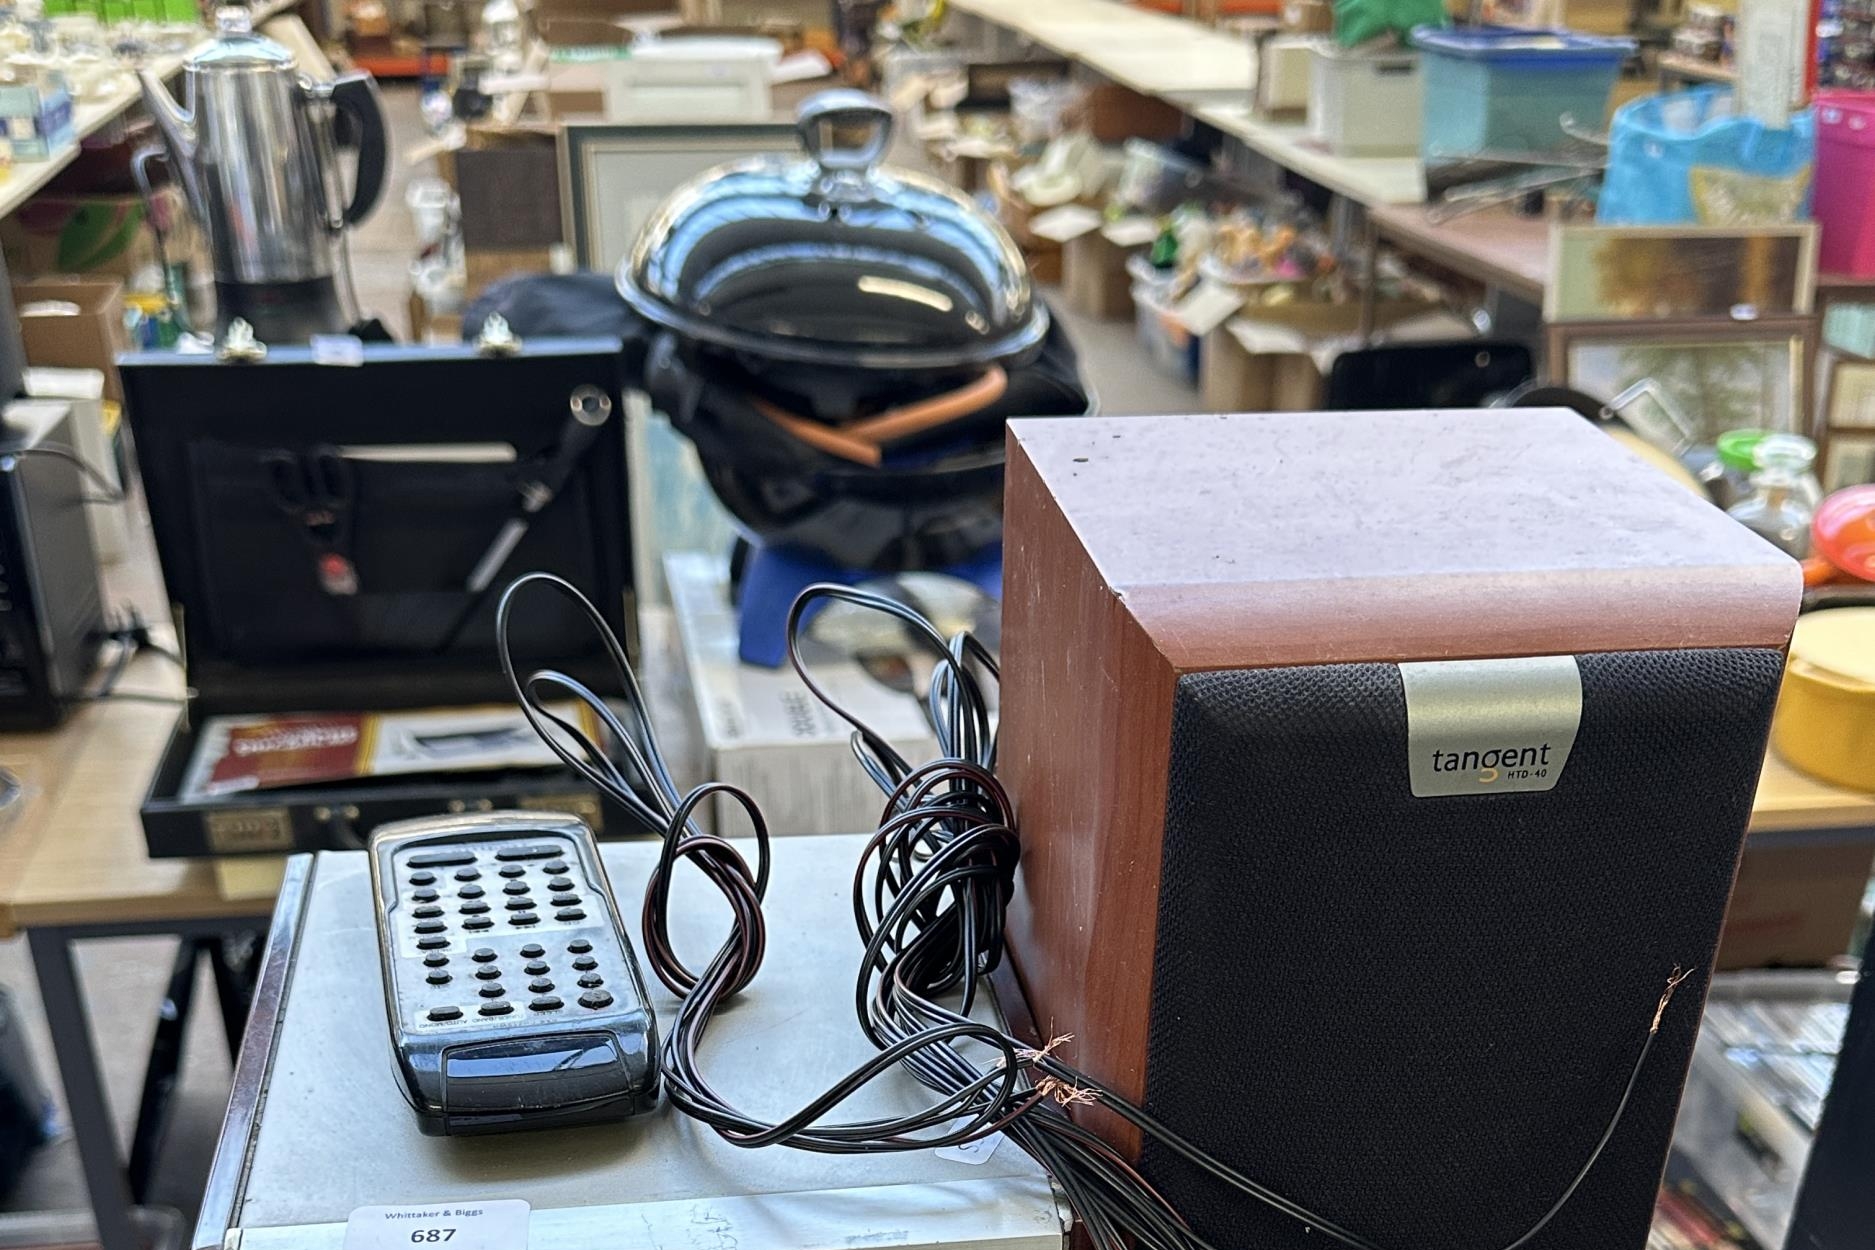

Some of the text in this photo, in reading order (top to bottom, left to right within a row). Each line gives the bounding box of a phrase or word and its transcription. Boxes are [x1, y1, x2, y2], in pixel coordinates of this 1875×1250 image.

[1432, 743, 1552, 784] tangent
[1507, 768, 1548, 780] HTD-40
[384, 1208, 484, 1220] Whittaker & Biggs
[410, 1228, 457, 1243] 687
